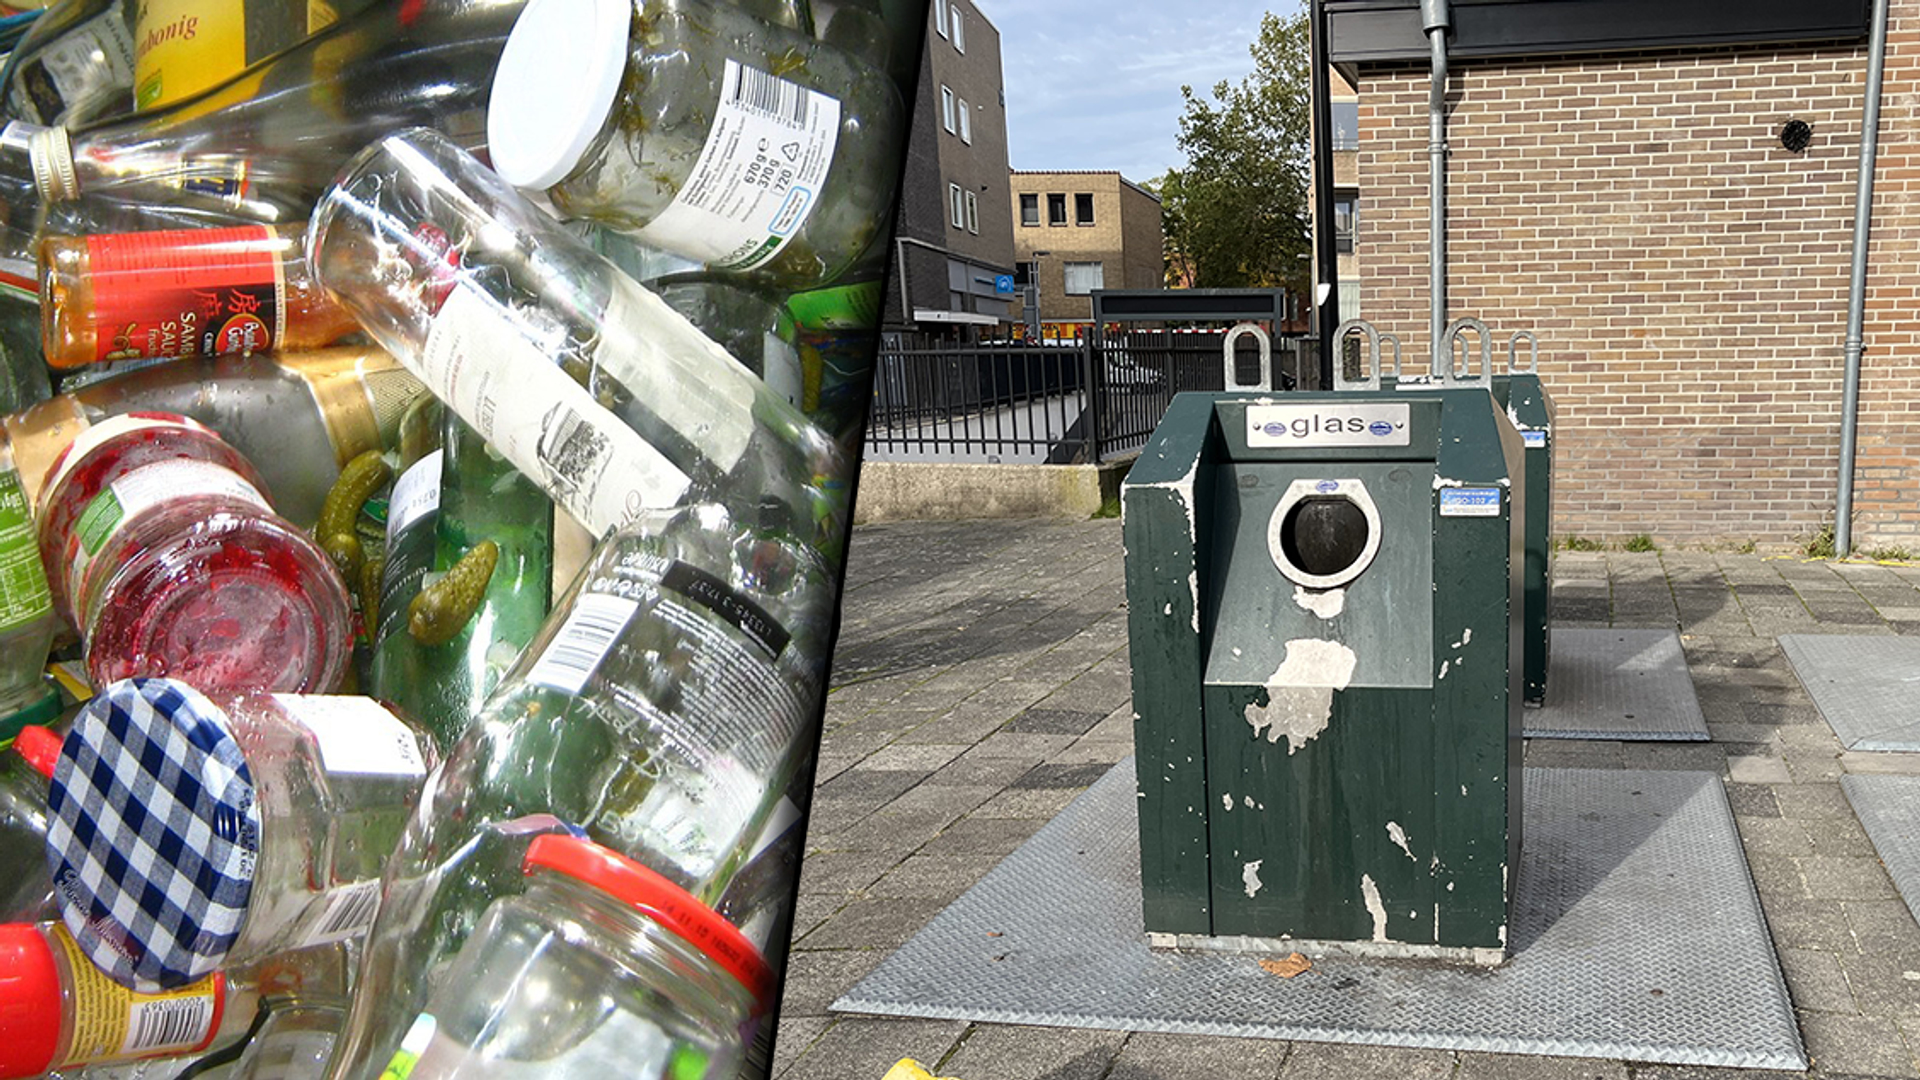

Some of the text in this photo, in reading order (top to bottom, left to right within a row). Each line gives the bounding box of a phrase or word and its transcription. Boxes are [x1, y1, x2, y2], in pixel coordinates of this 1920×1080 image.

[743, 162, 761, 184] 670
[757, 167, 775, 189] 370
[774, 169, 792, 191] 720
[1291, 414, 1365, 439] glas
